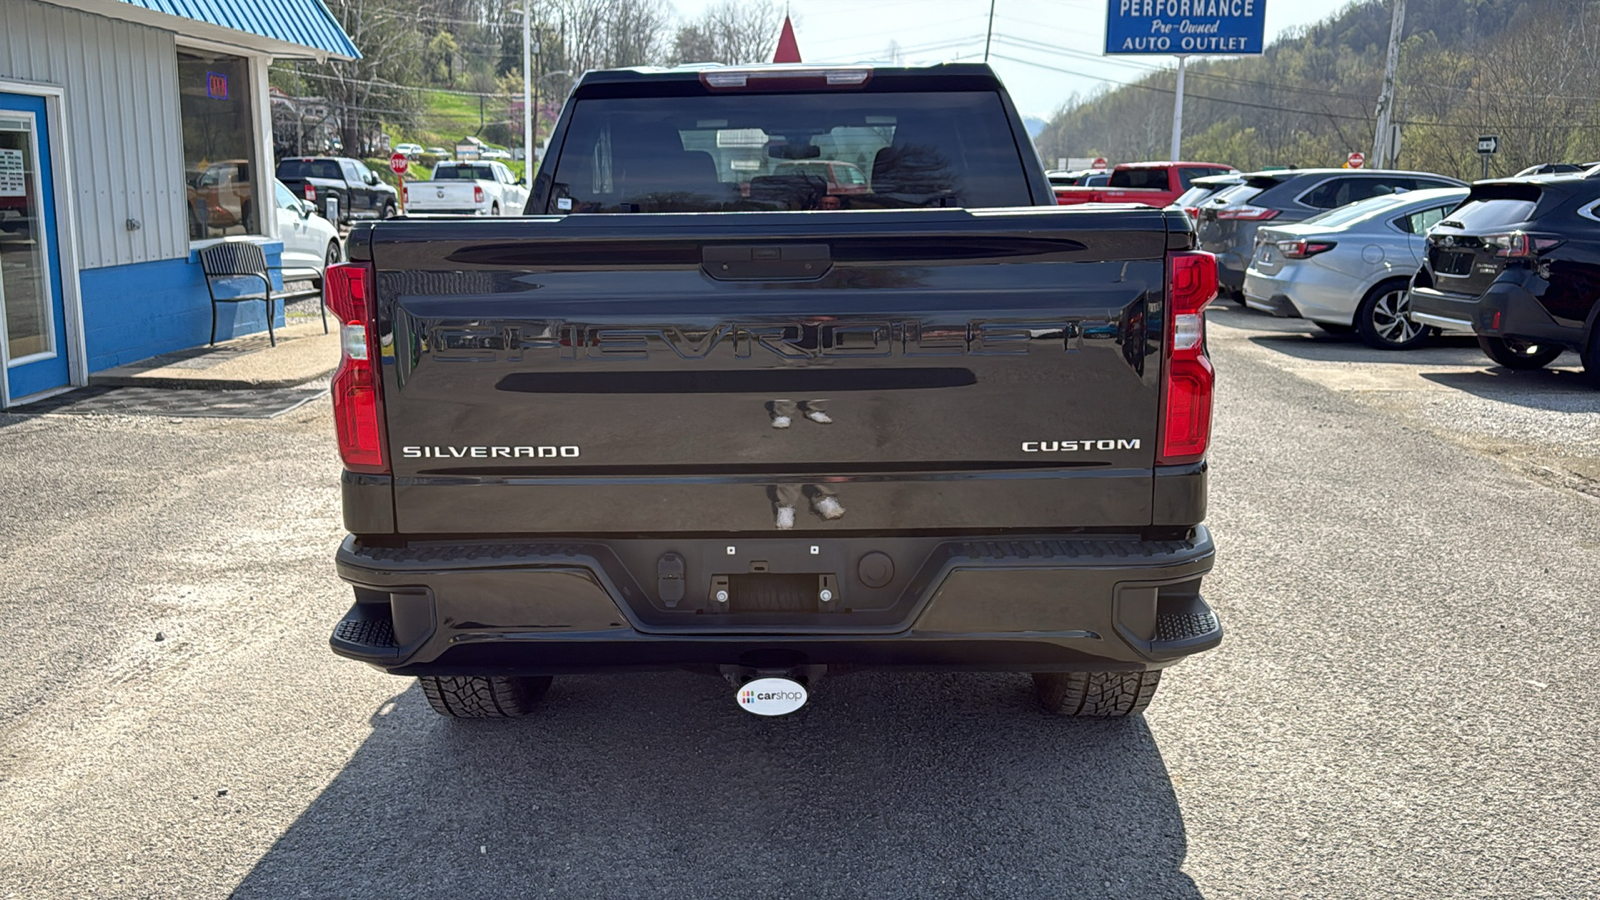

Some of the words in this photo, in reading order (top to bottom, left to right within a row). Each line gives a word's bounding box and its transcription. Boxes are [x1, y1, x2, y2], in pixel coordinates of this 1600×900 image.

[1119, 0, 1254, 17] PERFORMANCE
[1151, 19, 1220, 34] Pre-Owned
[1122, 37, 1171, 50] AUTO
[1181, 37, 1248, 50] OUTLET
[391, 158, 408, 169] STOP
[429, 322, 1113, 362] CHEVROLET
[402, 445, 580, 458] SILVERADO
[1021, 438, 1141, 452] CUSTOM
[757, 691, 802, 701] carshop
